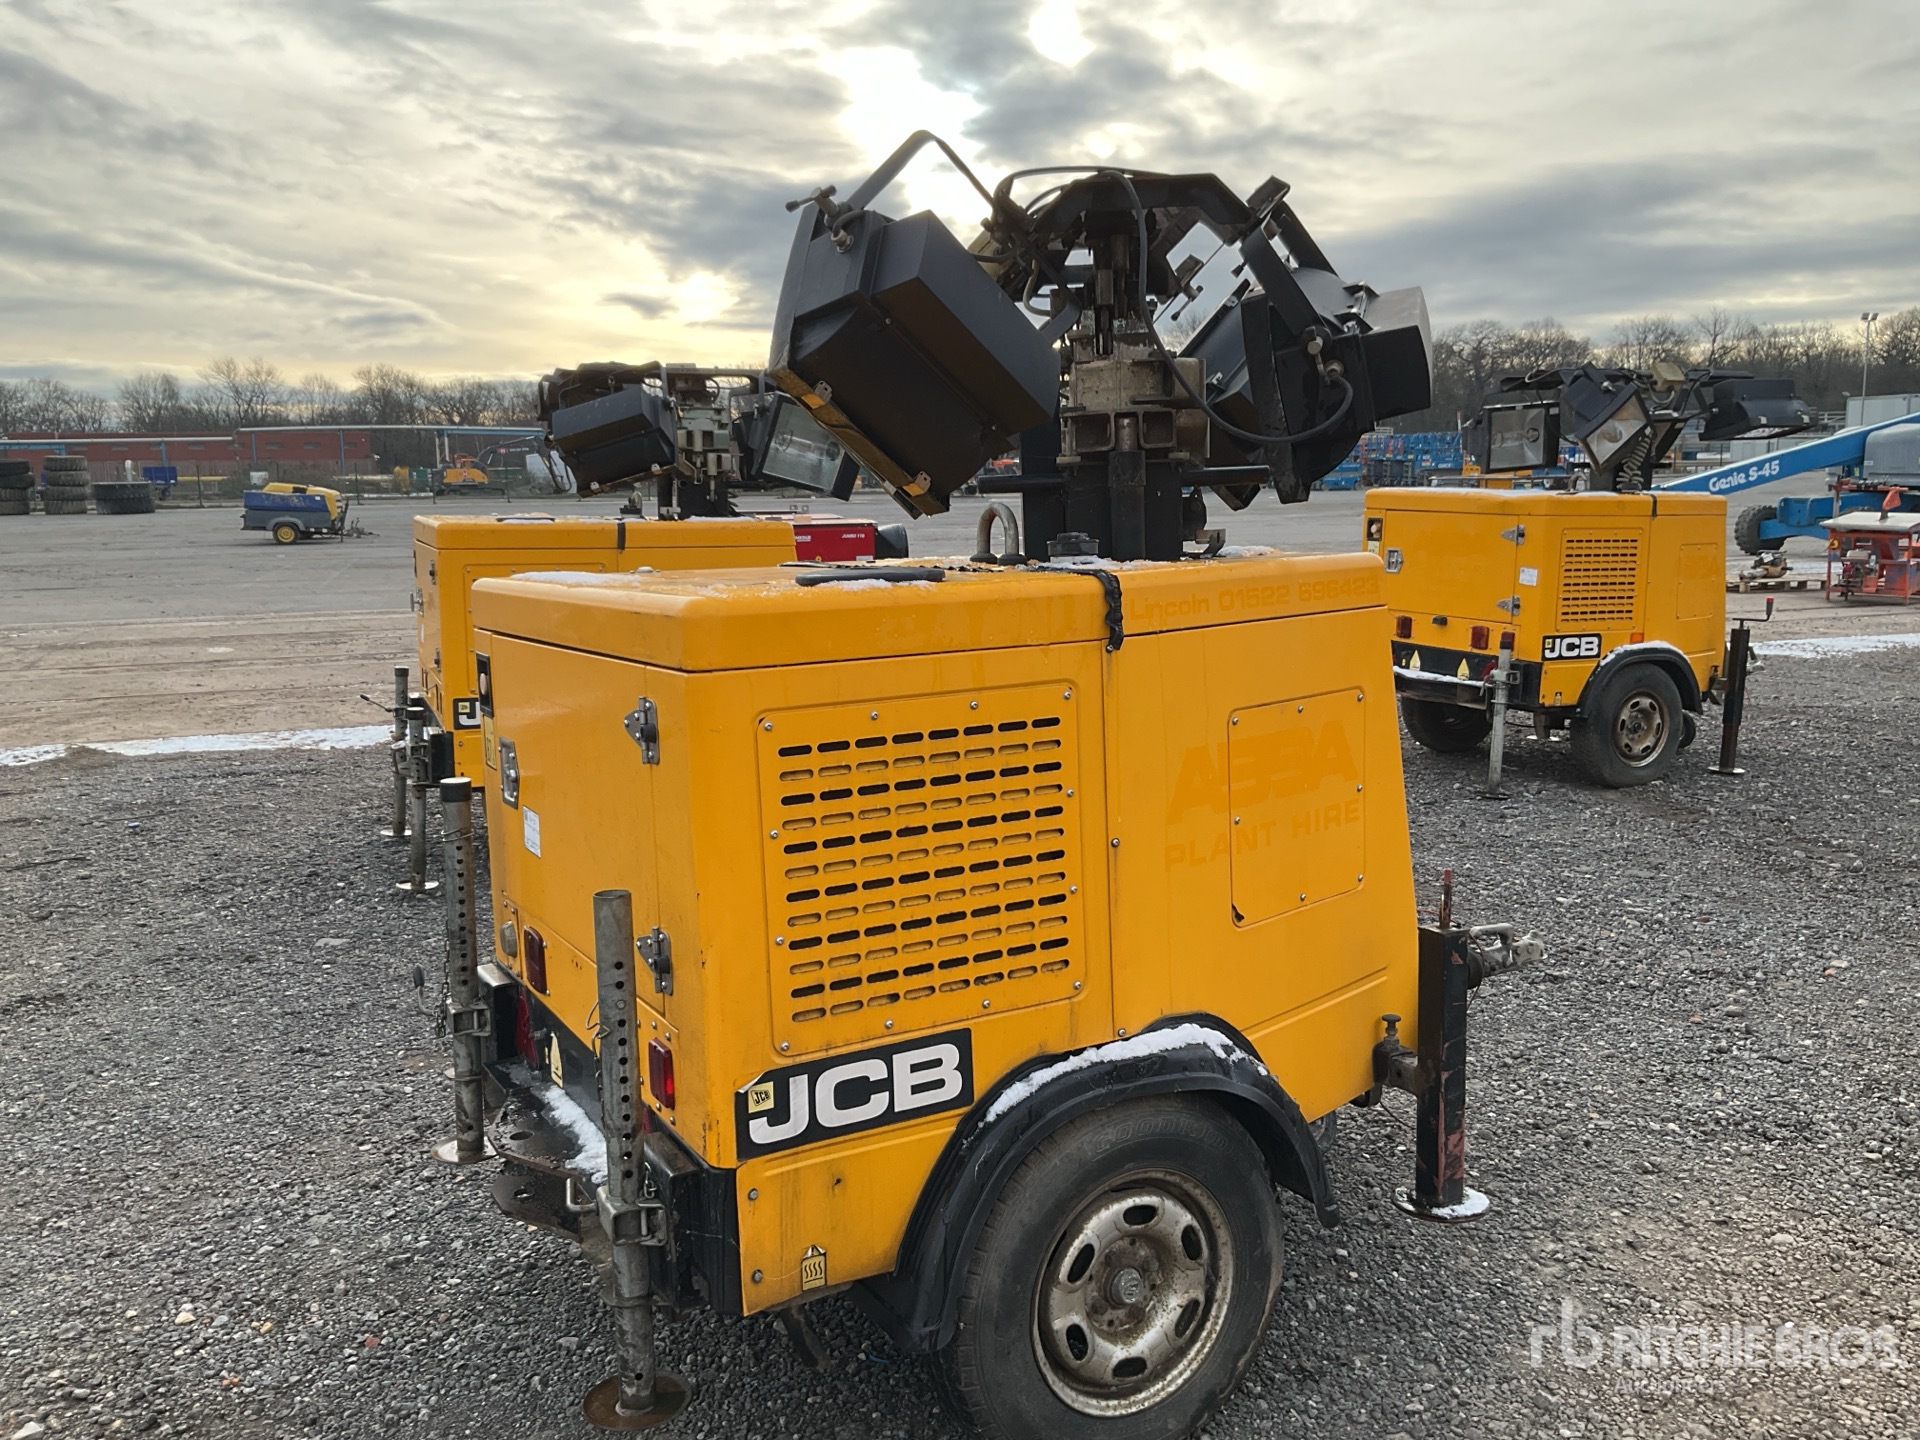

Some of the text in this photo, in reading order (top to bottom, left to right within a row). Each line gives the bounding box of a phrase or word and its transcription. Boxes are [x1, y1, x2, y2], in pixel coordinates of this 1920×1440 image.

[1709, 460, 1780, 492] Genie S-45
[1129, 592, 1210, 621] Lincoln
[1218, 585, 1290, 612] 01522
[1544, 636, 1599, 658] JCB
[1165, 798, 1361, 873] PLANT HIRE
[749, 1043, 963, 1145] JCB
[754, 1090, 770, 1105] JCB
